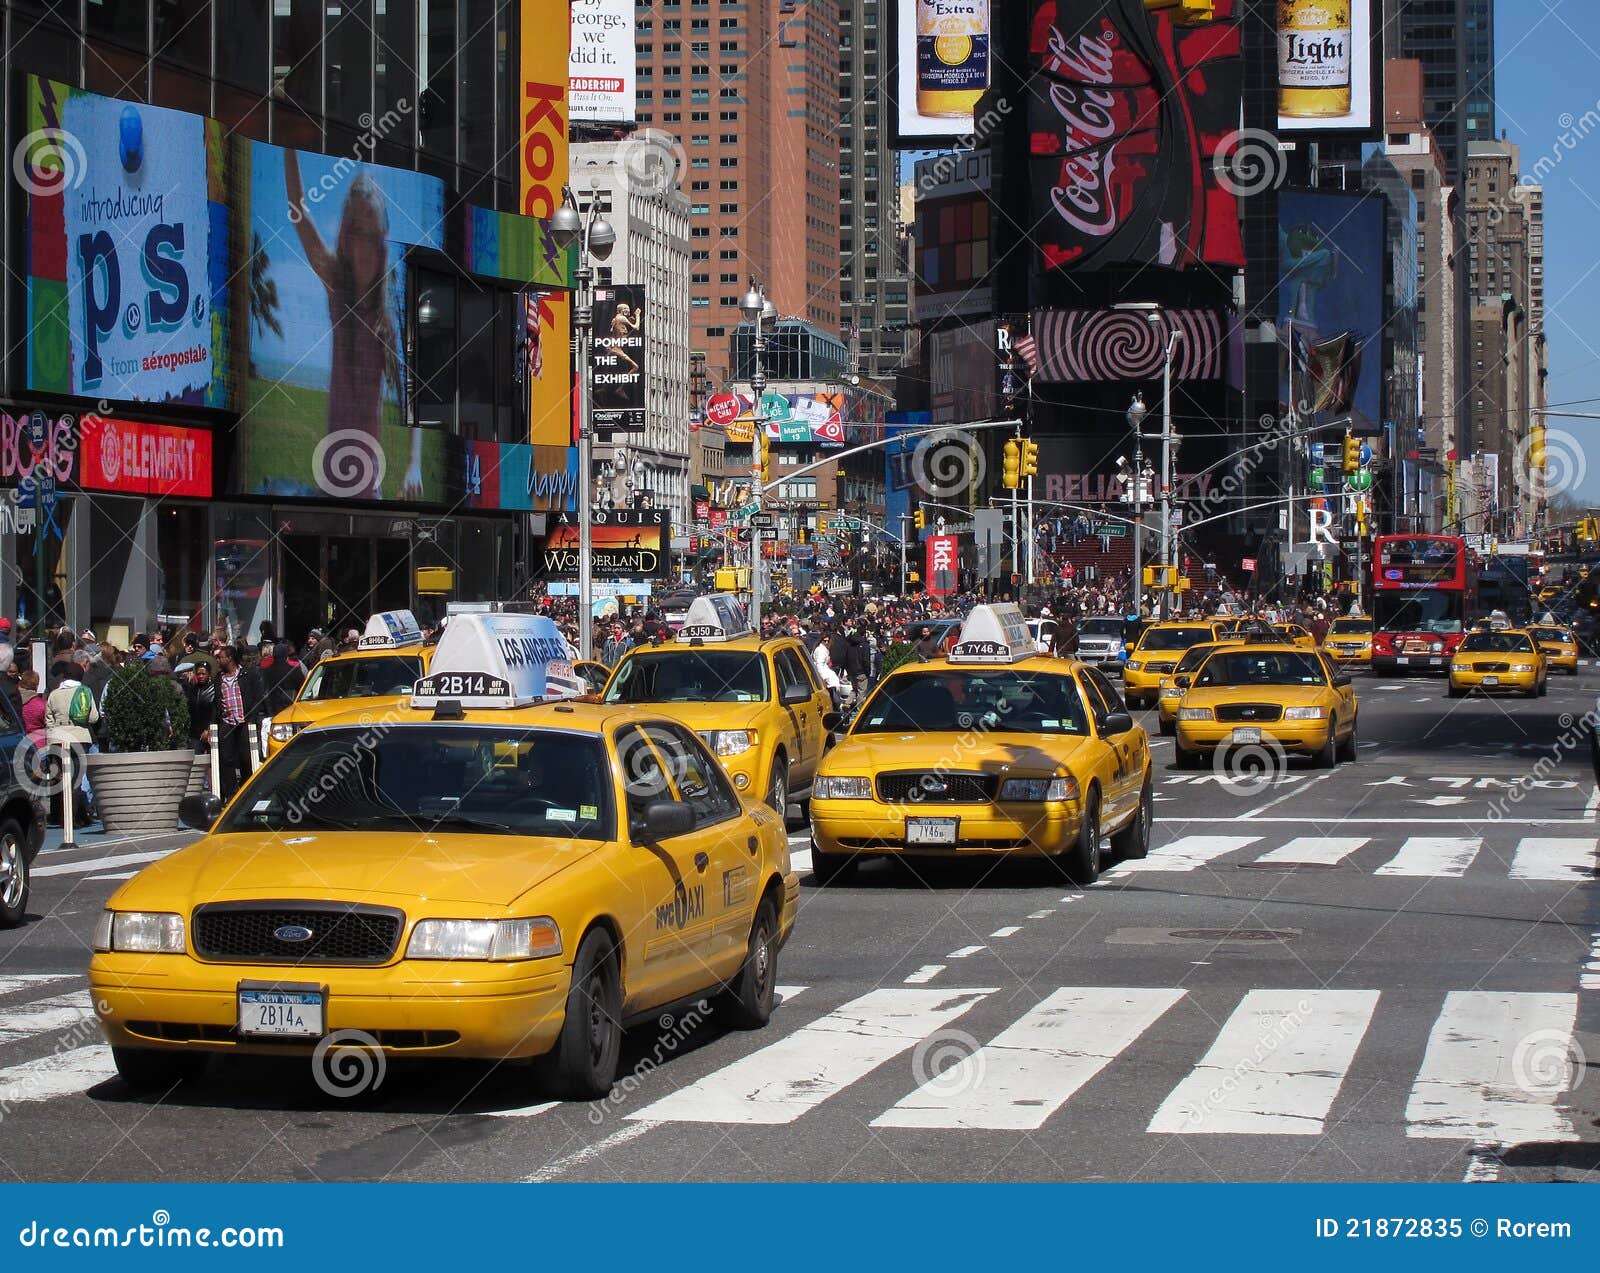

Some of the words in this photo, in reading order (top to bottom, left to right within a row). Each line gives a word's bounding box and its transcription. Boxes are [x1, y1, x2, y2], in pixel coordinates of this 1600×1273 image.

[936, 4, 975, 15] Extra
[583, 32, 605, 43] we
[571, 47, 597, 64] did
[602, 48, 617, 64] it.
[1286, 33, 1344, 64] Light
[569, 79, 621, 91] EADERSHIP
[1049, 24, 1116, 236] Coca-Cola
[81, 187, 165, 224] introducing
[79, 222, 206, 392] p.s.
[594, 337, 642, 347] POMPEII
[110, 356, 140, 377] from
[142, 344, 208, 372] aéropostale
[594, 356, 618, 366] THE
[594, 374, 640, 384] EXHIBIT
[784, 426, 806, 434] March
[2, 414, 74, 482] BCG
[123, 435, 195, 481] ELEMENT
[466, 455, 481, 495] 14
[526, 454, 578, 513] happy
[1046, 474, 1213, 500] RELIATY
[559, 512, 662, 523] AQUIS
[1307, 509, 1340, 543] R
[544, 551, 657, 572] WOERLAND
[690, 626, 710, 636] 5J50
[497, 638, 524, 666] LOS
[520, 638, 568, 665] ANGELES
[967, 644, 994, 654] 7Y46
[440, 676, 485, 694] 2B14
[261, 994, 279, 1003] NEW
[260, 1005, 304, 1026] 2B14A
